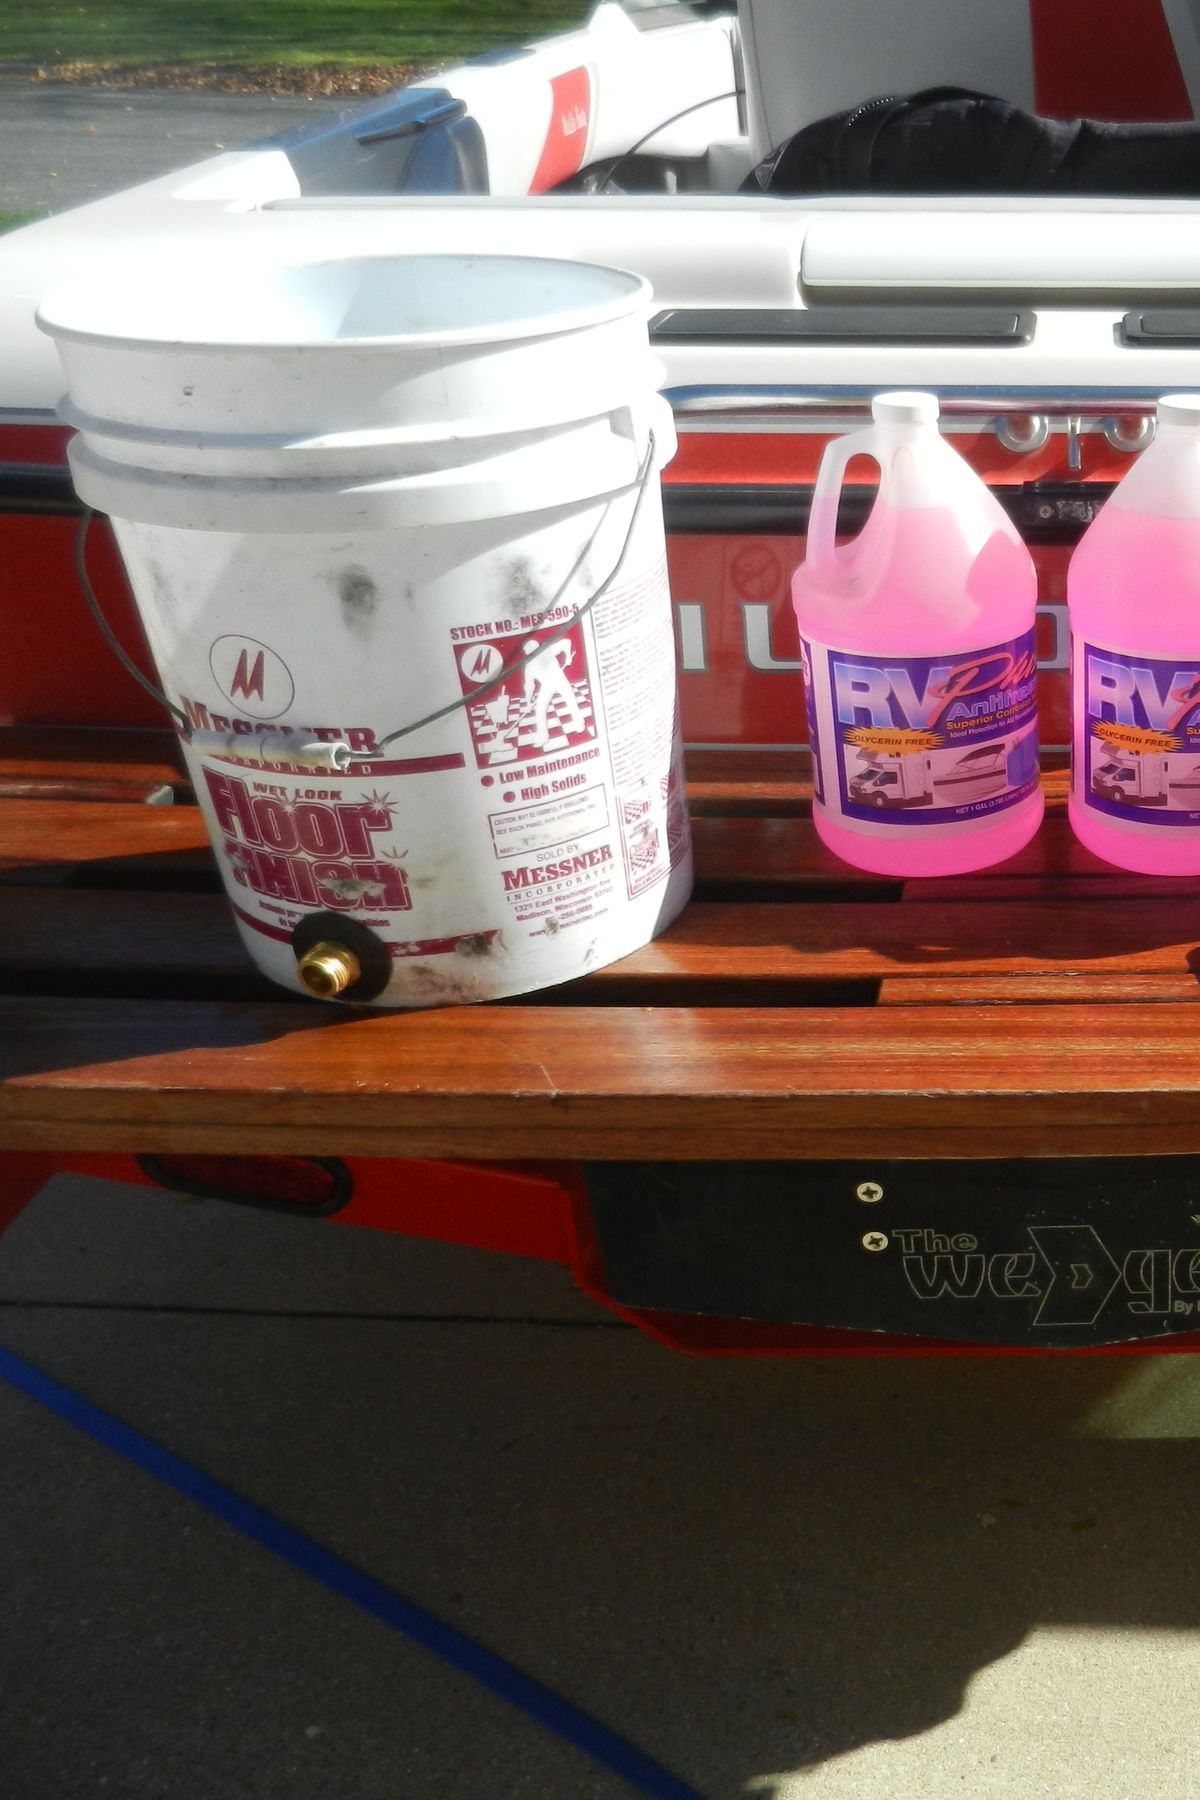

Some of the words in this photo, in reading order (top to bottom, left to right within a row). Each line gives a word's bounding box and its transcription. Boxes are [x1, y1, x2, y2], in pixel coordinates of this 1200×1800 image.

[450, 622, 494, 641] STOCK
[833, 661, 953, 729] RV
[1088, 654, 1199, 732] RV
[946, 714, 993, 730] Superior
[854, 735, 902, 745] GLYCERIN
[905, 738, 932, 746] FREE
[950, 730, 967, 738] Ideal
[1099, 728, 1143, 744] GLYCERIN
[1145, 738, 1172, 747] FREE
[499, 769, 524, 784] Low
[526, 747, 600, 778] Maintenance
[252, 781, 287, 797] WET
[294, 788, 342, 801] LOOK
[520, 785, 549, 800] High
[551, 773, 587, 793] Solids
[956, 806, 969, 814] NET
[975, 803, 988, 811] GAL
[536, 848, 564, 862] SOLD
[501, 844, 613, 891] MESSNER
[506, 863, 615, 902] INCORPORATED
[535, 898, 553, 908] East
[554, 883, 598, 903] Washington
[554, 895, 594, 912] Wisconsin
[892, 1228, 978, 1254] The
[1174, 1300, 1193, 1315] By
